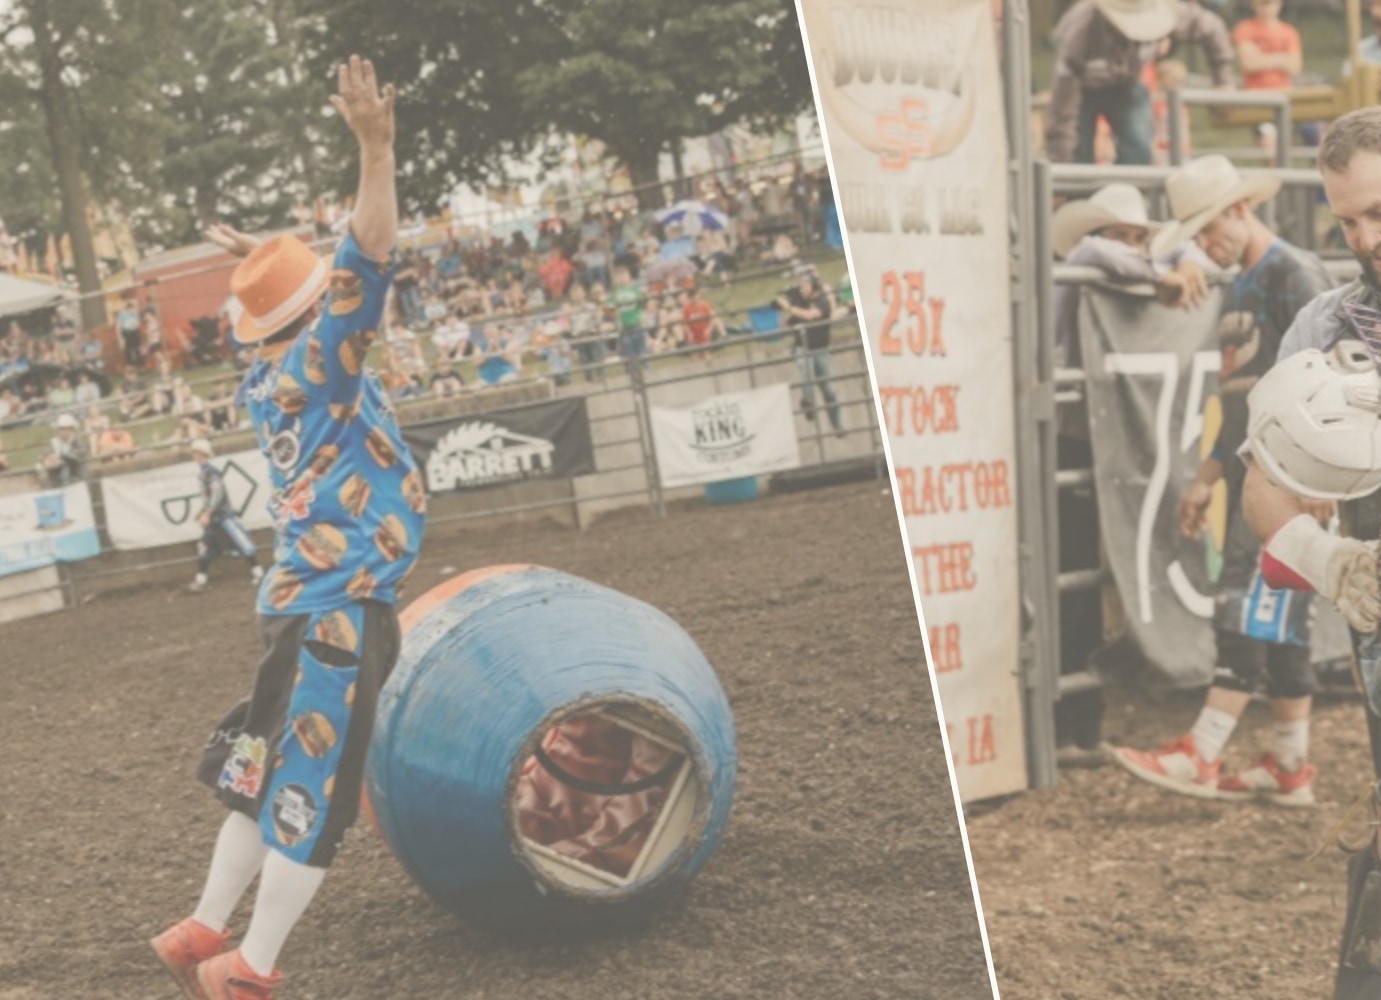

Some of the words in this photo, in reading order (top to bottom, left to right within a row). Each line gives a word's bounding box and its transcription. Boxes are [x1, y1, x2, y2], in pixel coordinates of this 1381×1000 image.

[427, 450, 552, 491] BARRETT
[912, 541, 977, 596] THE
[965, 713, 996, 766] IA
